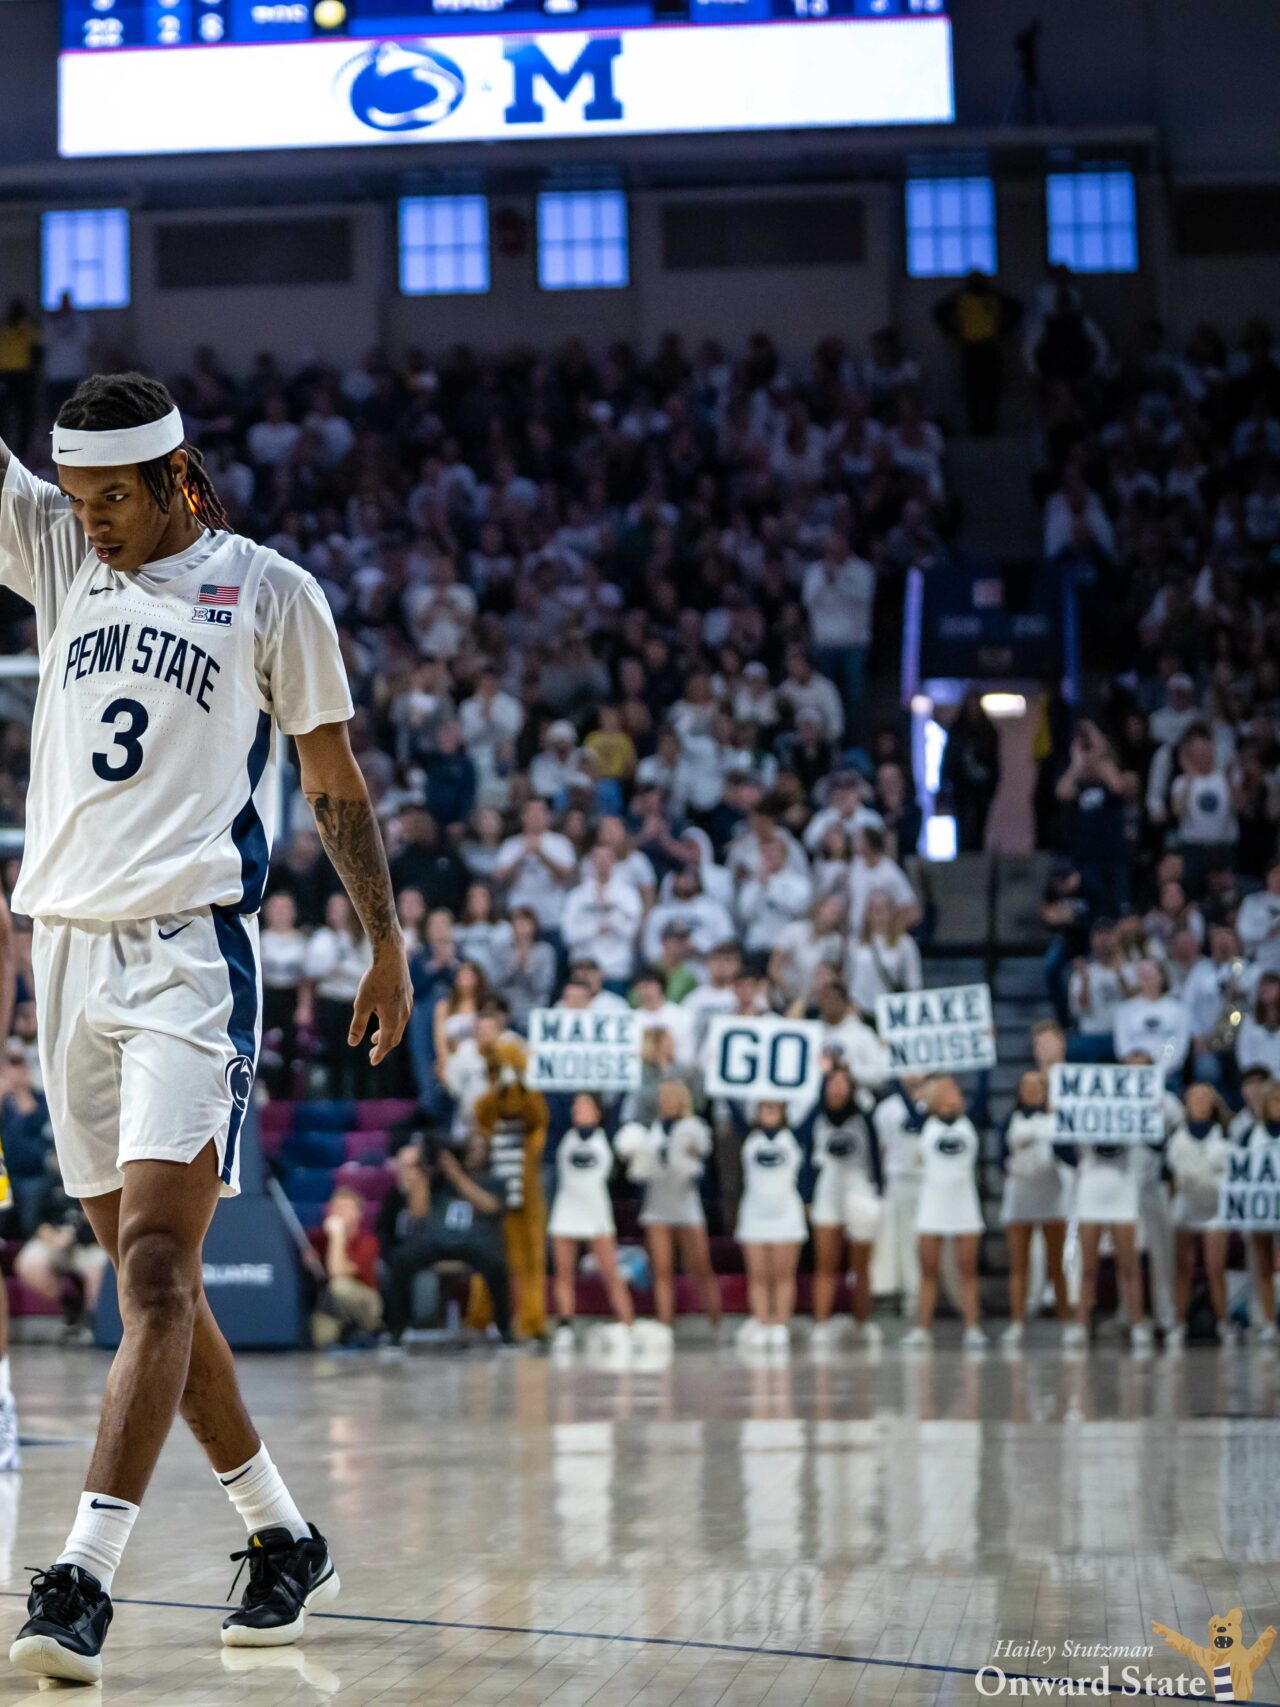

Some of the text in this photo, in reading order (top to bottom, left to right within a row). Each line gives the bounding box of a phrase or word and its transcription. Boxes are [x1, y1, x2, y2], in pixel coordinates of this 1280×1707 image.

[502, 35, 624, 123] M
[63, 624, 221, 714] PENN STATE
[92, 698, 149, 782] 3
[887, 988, 981, 1028] MAKE
[540, 1013, 634, 1043] MAKE
[537, 1050, 634, 1079] NOISE
[720, 1028, 809, 1087] GO
[889, 1031, 988, 1068] NOISE
[1060, 1066, 1155, 1098] MAKE
[1056, 1105, 1155, 1135] NOISE
